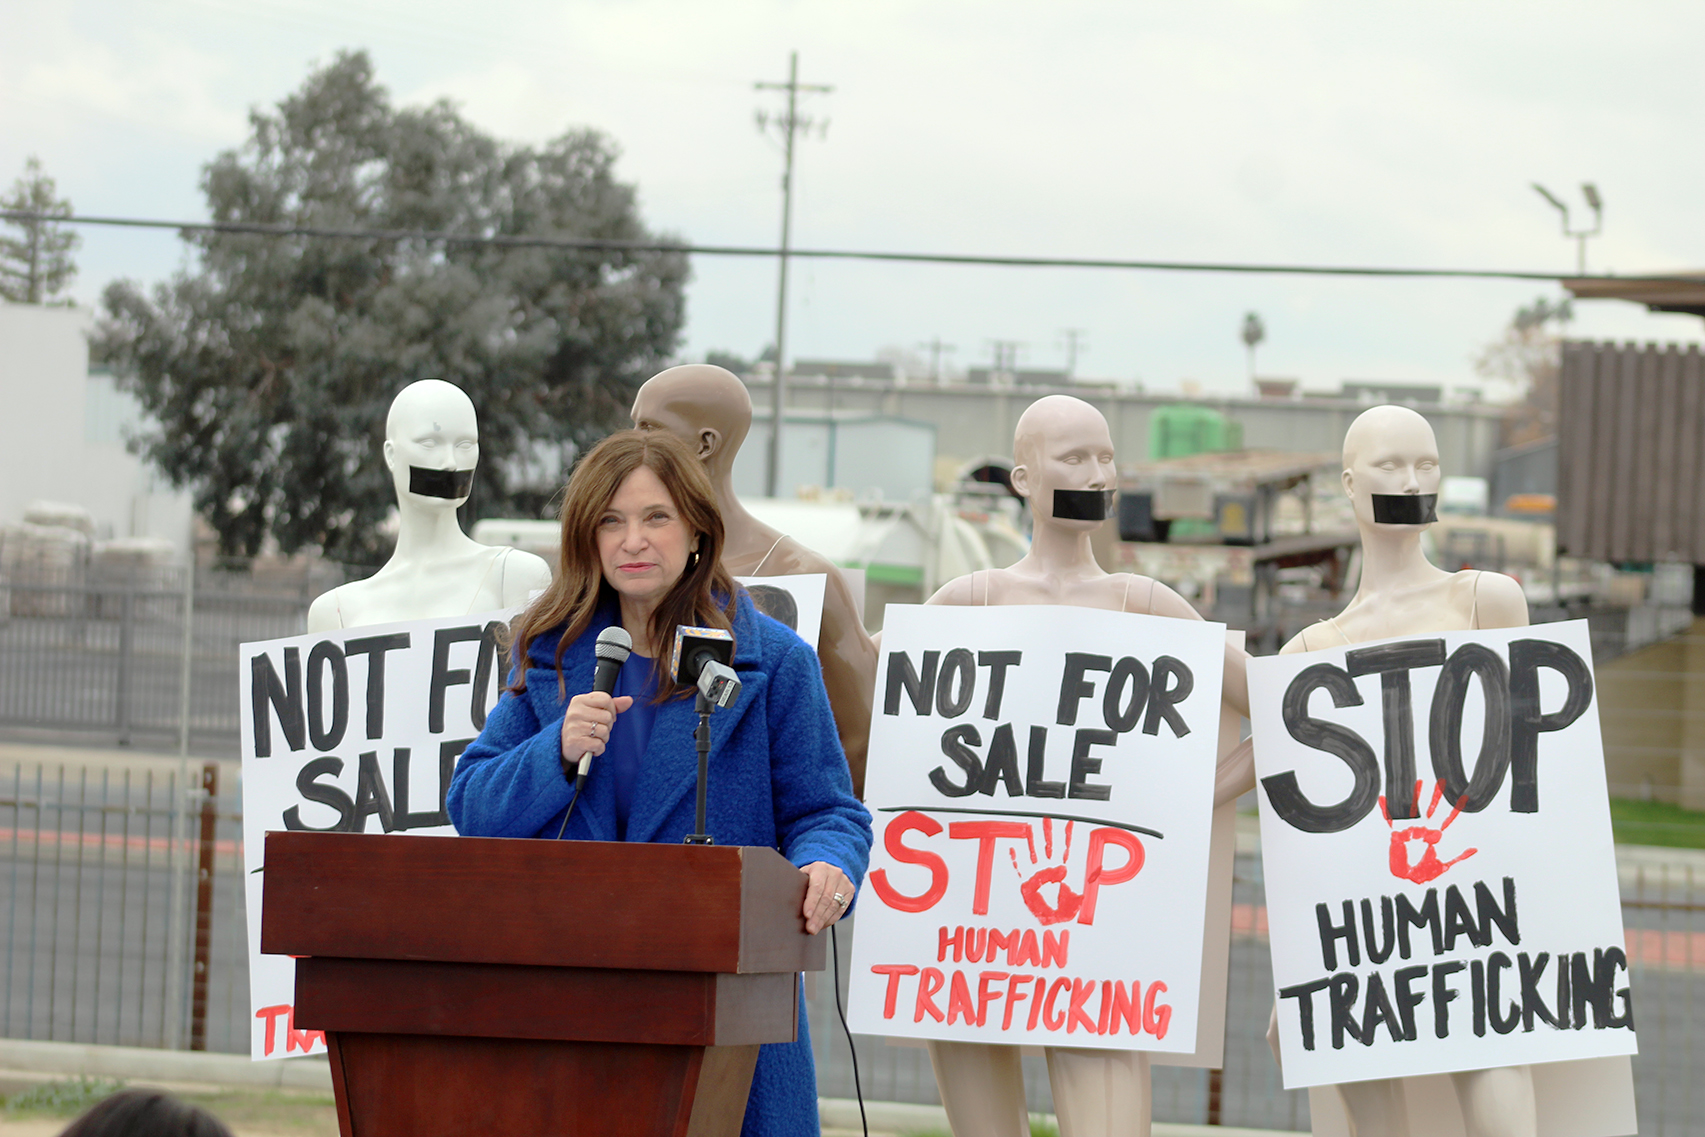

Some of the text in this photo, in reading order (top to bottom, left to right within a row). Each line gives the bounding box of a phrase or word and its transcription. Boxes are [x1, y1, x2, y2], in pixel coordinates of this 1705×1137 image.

[252, 615, 523, 758] NOT FO
[883, 647, 1195, 739] NOT FOR
[928, 723, 1118, 801] SALE
[1260, 637, 1594, 833] STOP
[937, 925, 1070, 968] HUMAN
[1315, 876, 1521, 972] HUMAN
[871, 964, 1172, 1040] TRAFFICKING
[1277, 945, 1636, 1052] TRAFFICKING
